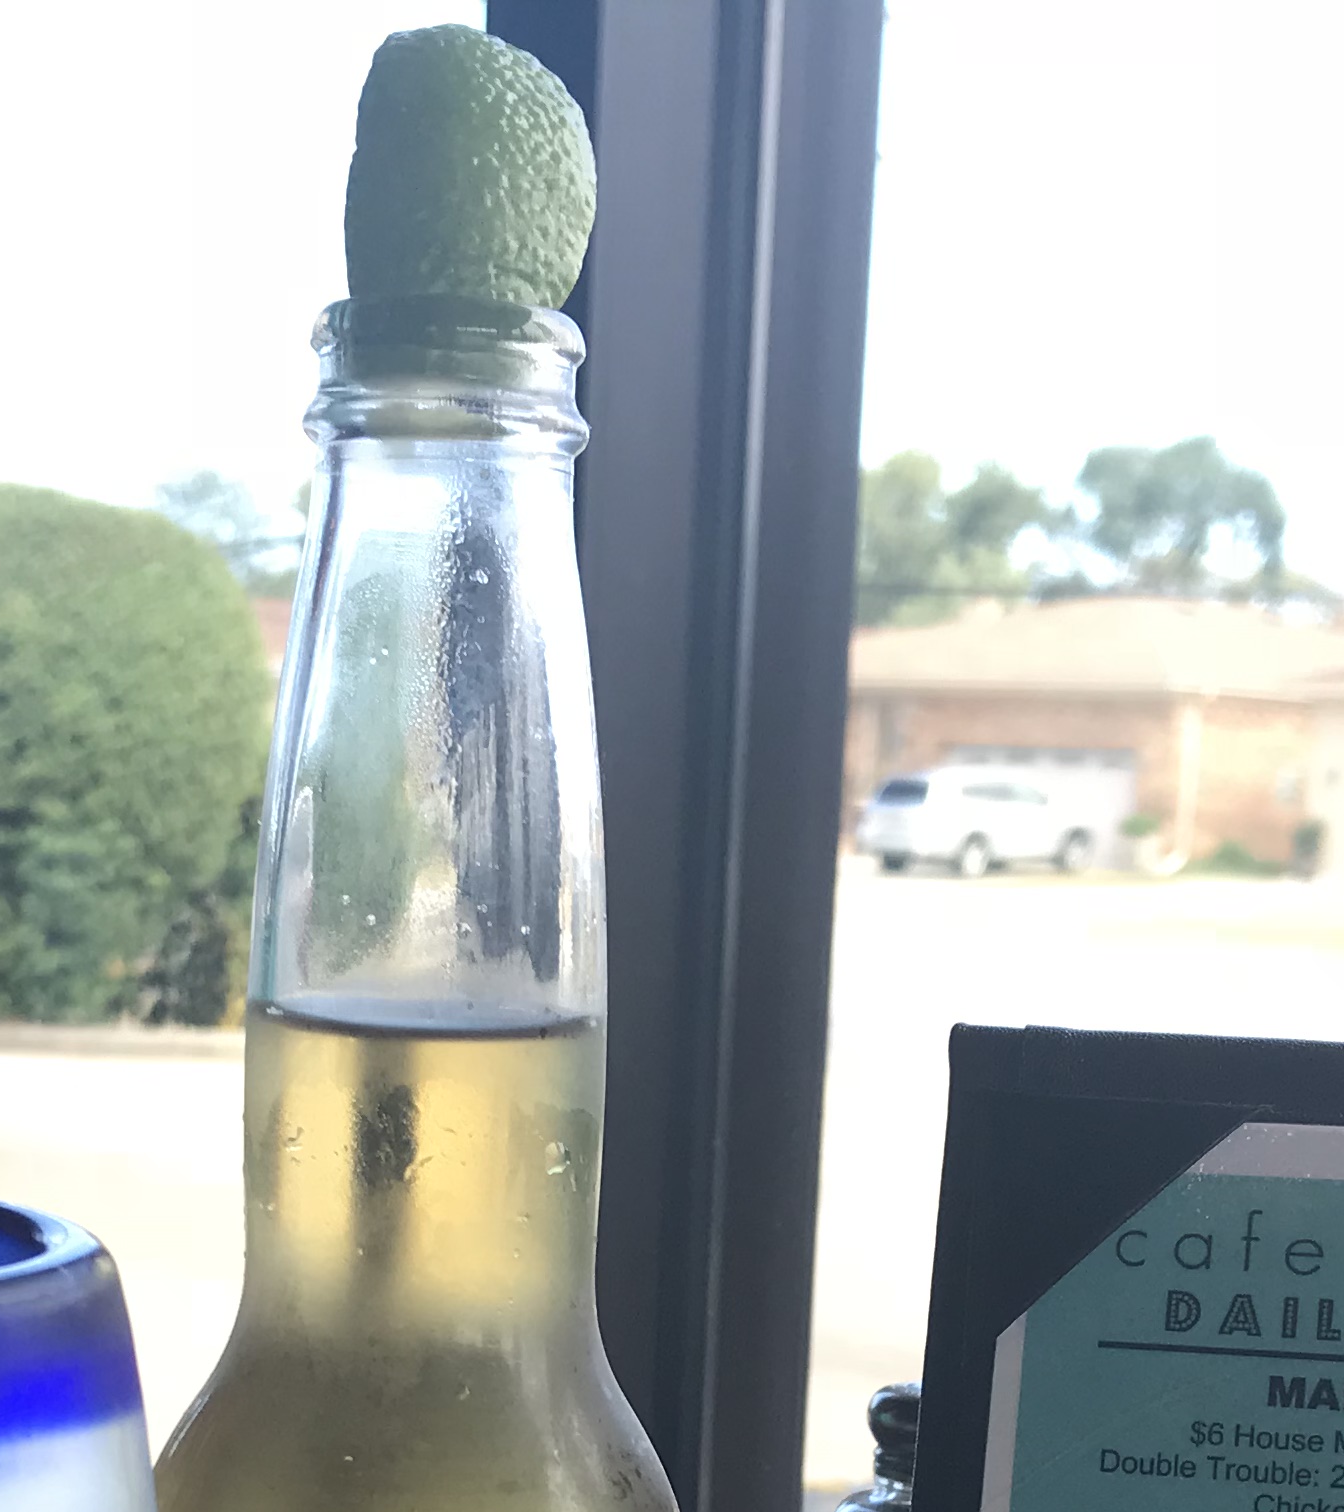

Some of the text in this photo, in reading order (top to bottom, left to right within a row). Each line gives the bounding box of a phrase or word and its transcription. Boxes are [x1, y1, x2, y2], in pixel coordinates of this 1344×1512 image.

[1115, 1209, 1323, 1275] cafe
[1190, 1420, 1223, 1447] $6
[1234, 1423, 1323, 1452] House
[1099, 1449, 1196, 1478] Double
[1207, 1455, 1318, 1486] Trouble:
